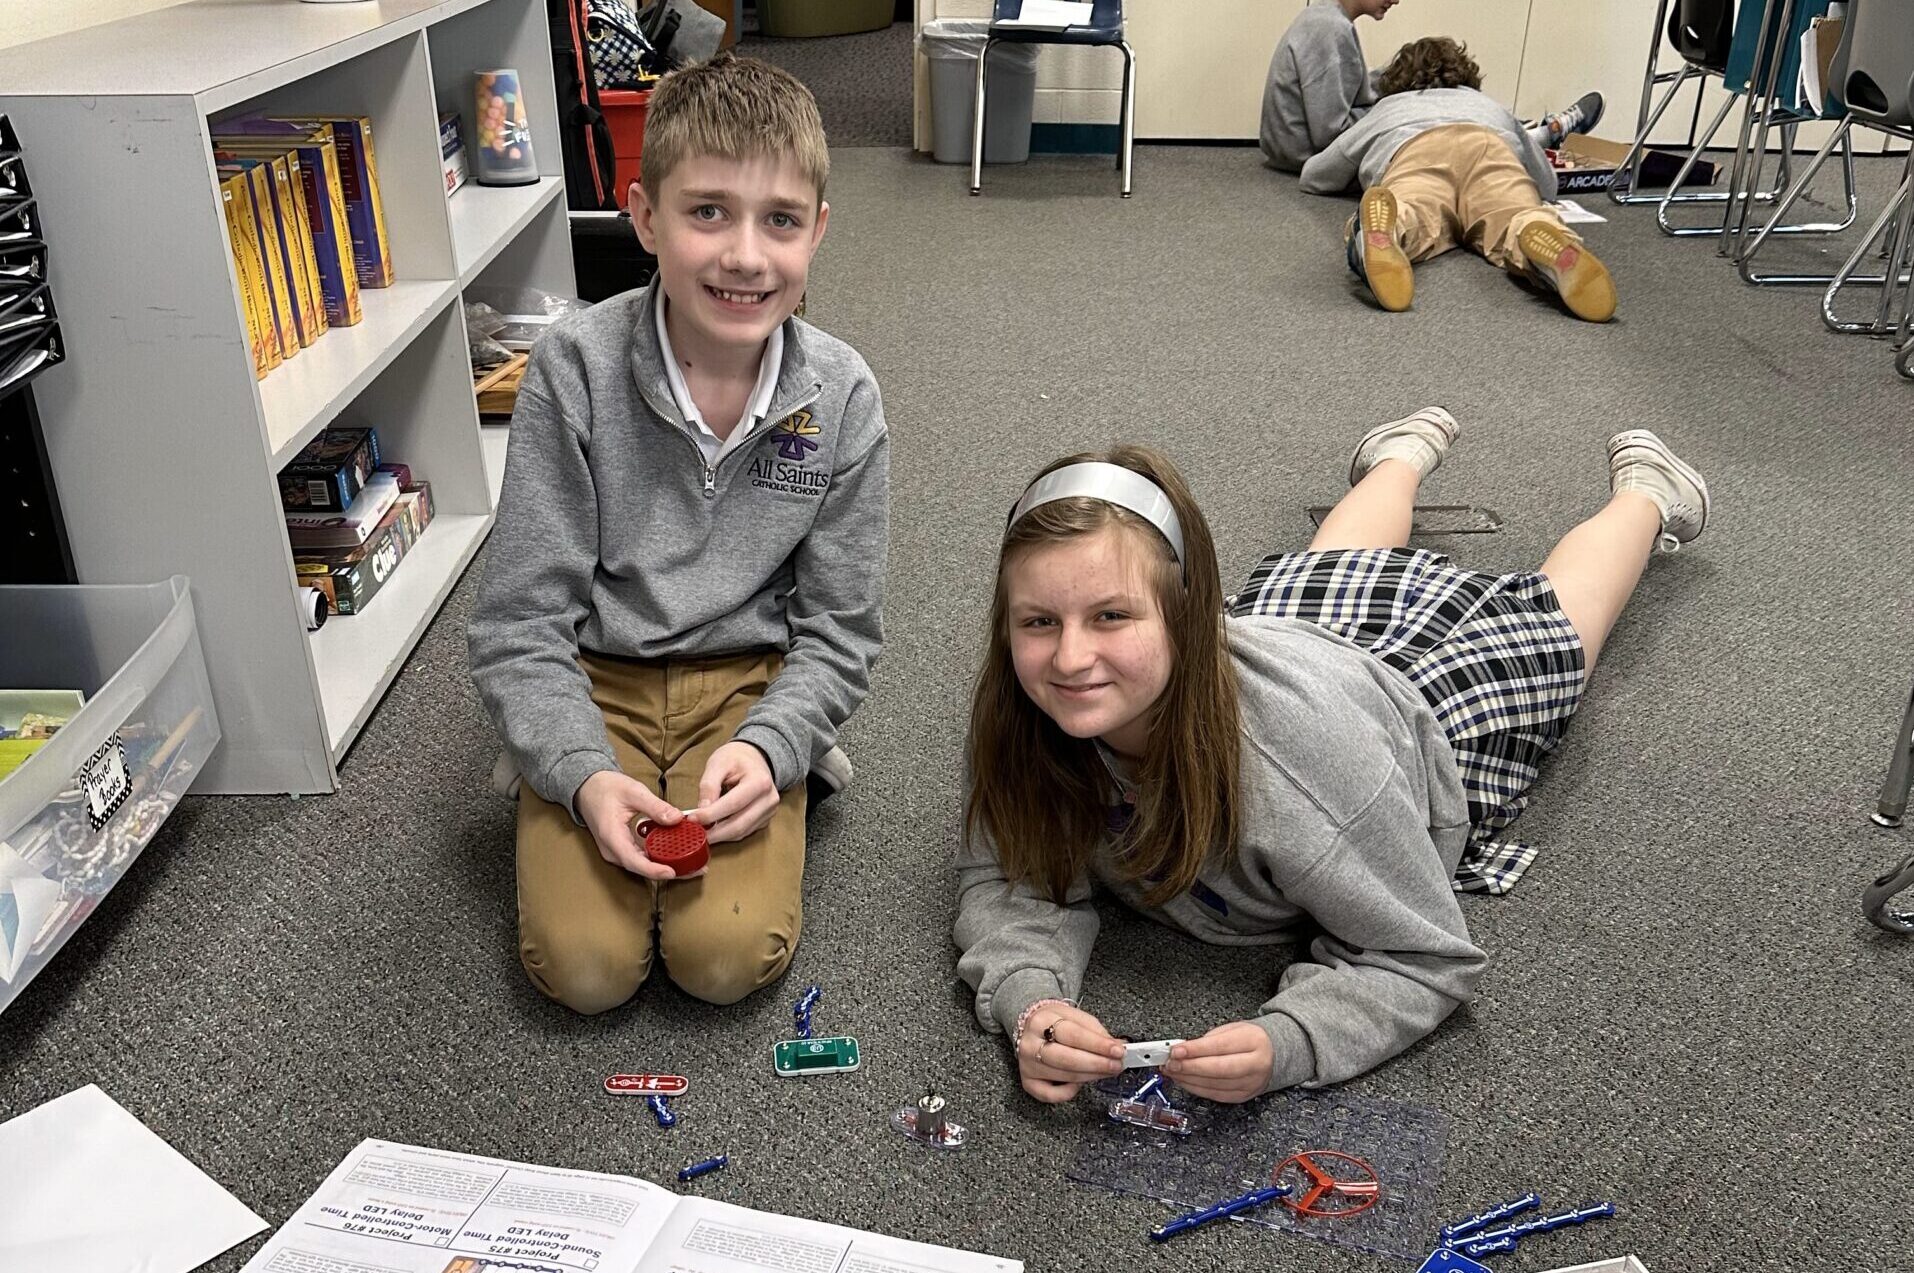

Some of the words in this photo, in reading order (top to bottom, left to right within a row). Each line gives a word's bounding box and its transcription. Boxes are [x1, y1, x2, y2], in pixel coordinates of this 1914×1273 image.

[747, 457, 773, 480] All
[775, 462, 829, 487] Saints
[751, 479, 789, 492] CATHOLIC
[790, 485, 820, 496] SCHOOL
[372, 544, 397, 583] Clue
[87, 758, 111, 791] Prayer
[99, 776, 121, 806] Books
[320, 1206, 349, 1219] Time
[362, 1204, 386, 1215] LED
[390, 1208, 424, 1222] Delay
[342, 1222, 366, 1233] #76
[351, 1212, 453, 1237] Motor-Controlled
[507, 1226, 531, 1237] LED
[369, 1226, 413, 1241] Project
[463, 1230, 491, 1242] Time
[535, 1227, 570, 1242] Delay
[489, 1245, 513, 1255] #75
[495, 1234, 602, 1259] Sound-Controlled
[514, 1247, 560, 1261] Project
